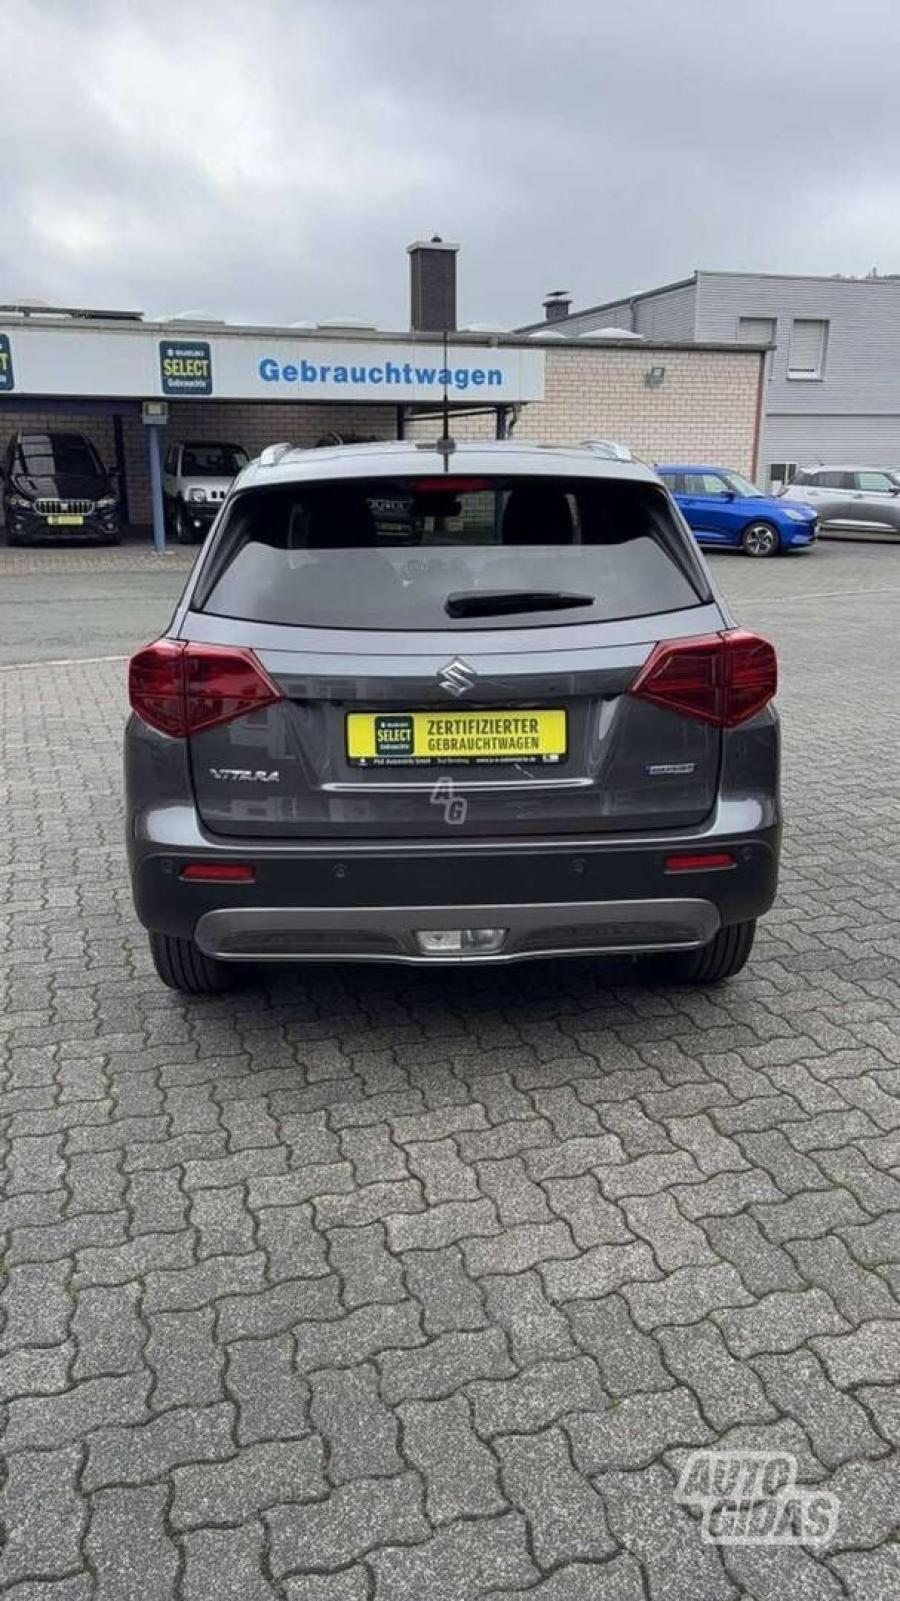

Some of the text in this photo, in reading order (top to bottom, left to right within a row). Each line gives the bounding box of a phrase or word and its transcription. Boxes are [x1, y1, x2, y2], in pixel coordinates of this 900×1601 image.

[163, 359, 209, 376] SELECT
[259, 358, 503, 389] Gebrauchtwagen
[427, 718, 538, 735] ZERTIFIZIERTER
[377, 729, 411, 742] SELECT
[428, 736, 539, 751] GEBRAUCHTWAGEN
[209, 768, 280, 782] VITARA
